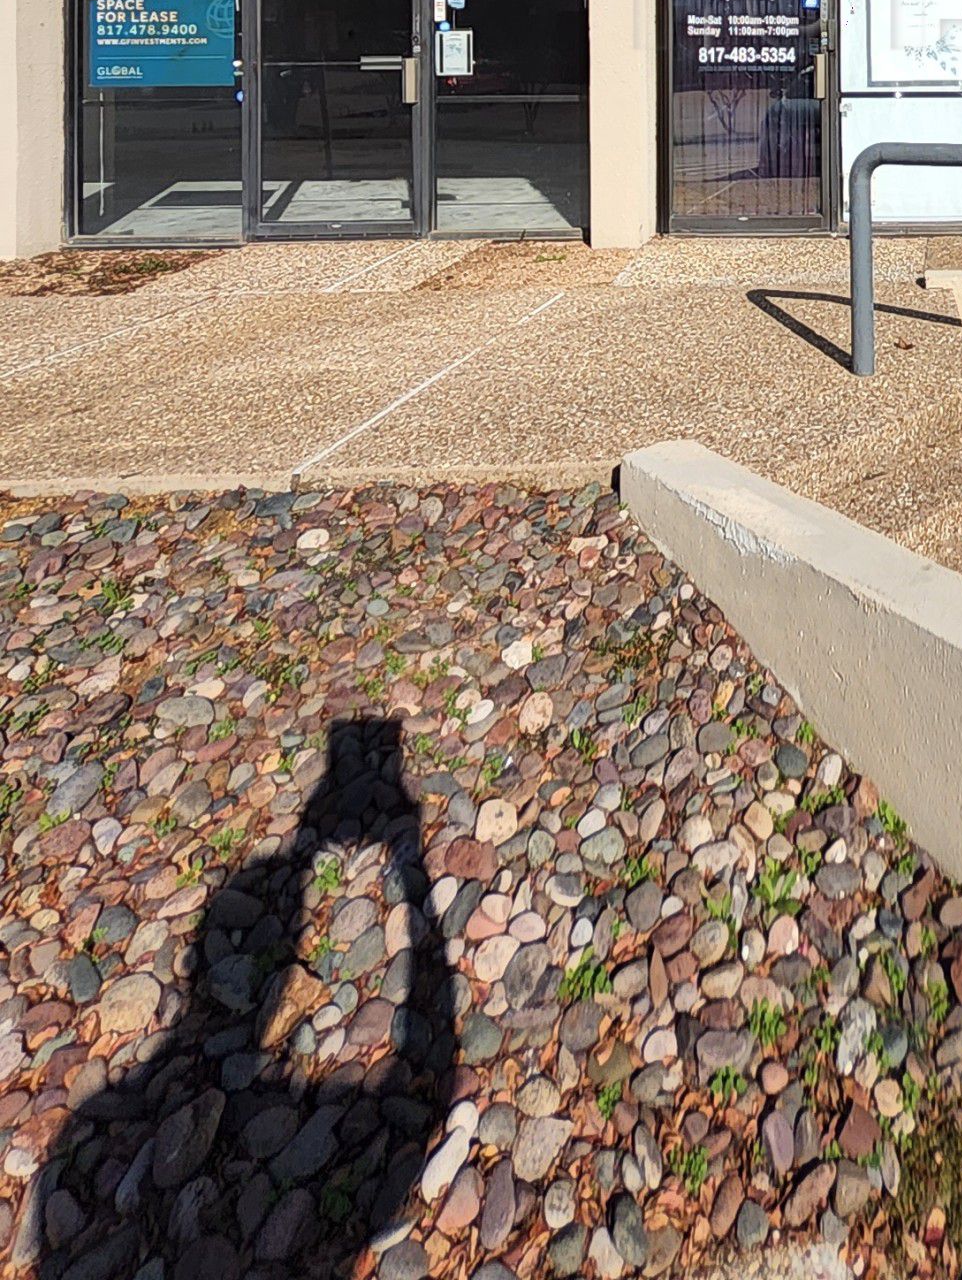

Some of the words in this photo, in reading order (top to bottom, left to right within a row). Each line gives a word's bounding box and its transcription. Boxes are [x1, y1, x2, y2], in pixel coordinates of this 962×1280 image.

[96, 0, 145, 10] SPACE
[96, 11, 126, 23] FOR
[130, 11, 179, 23] LEASE
[96, 24, 198, 36] 817.478.9400
[687, 27, 722, 37] Sunday
[698, 47, 796, 64] 817-483-5354
